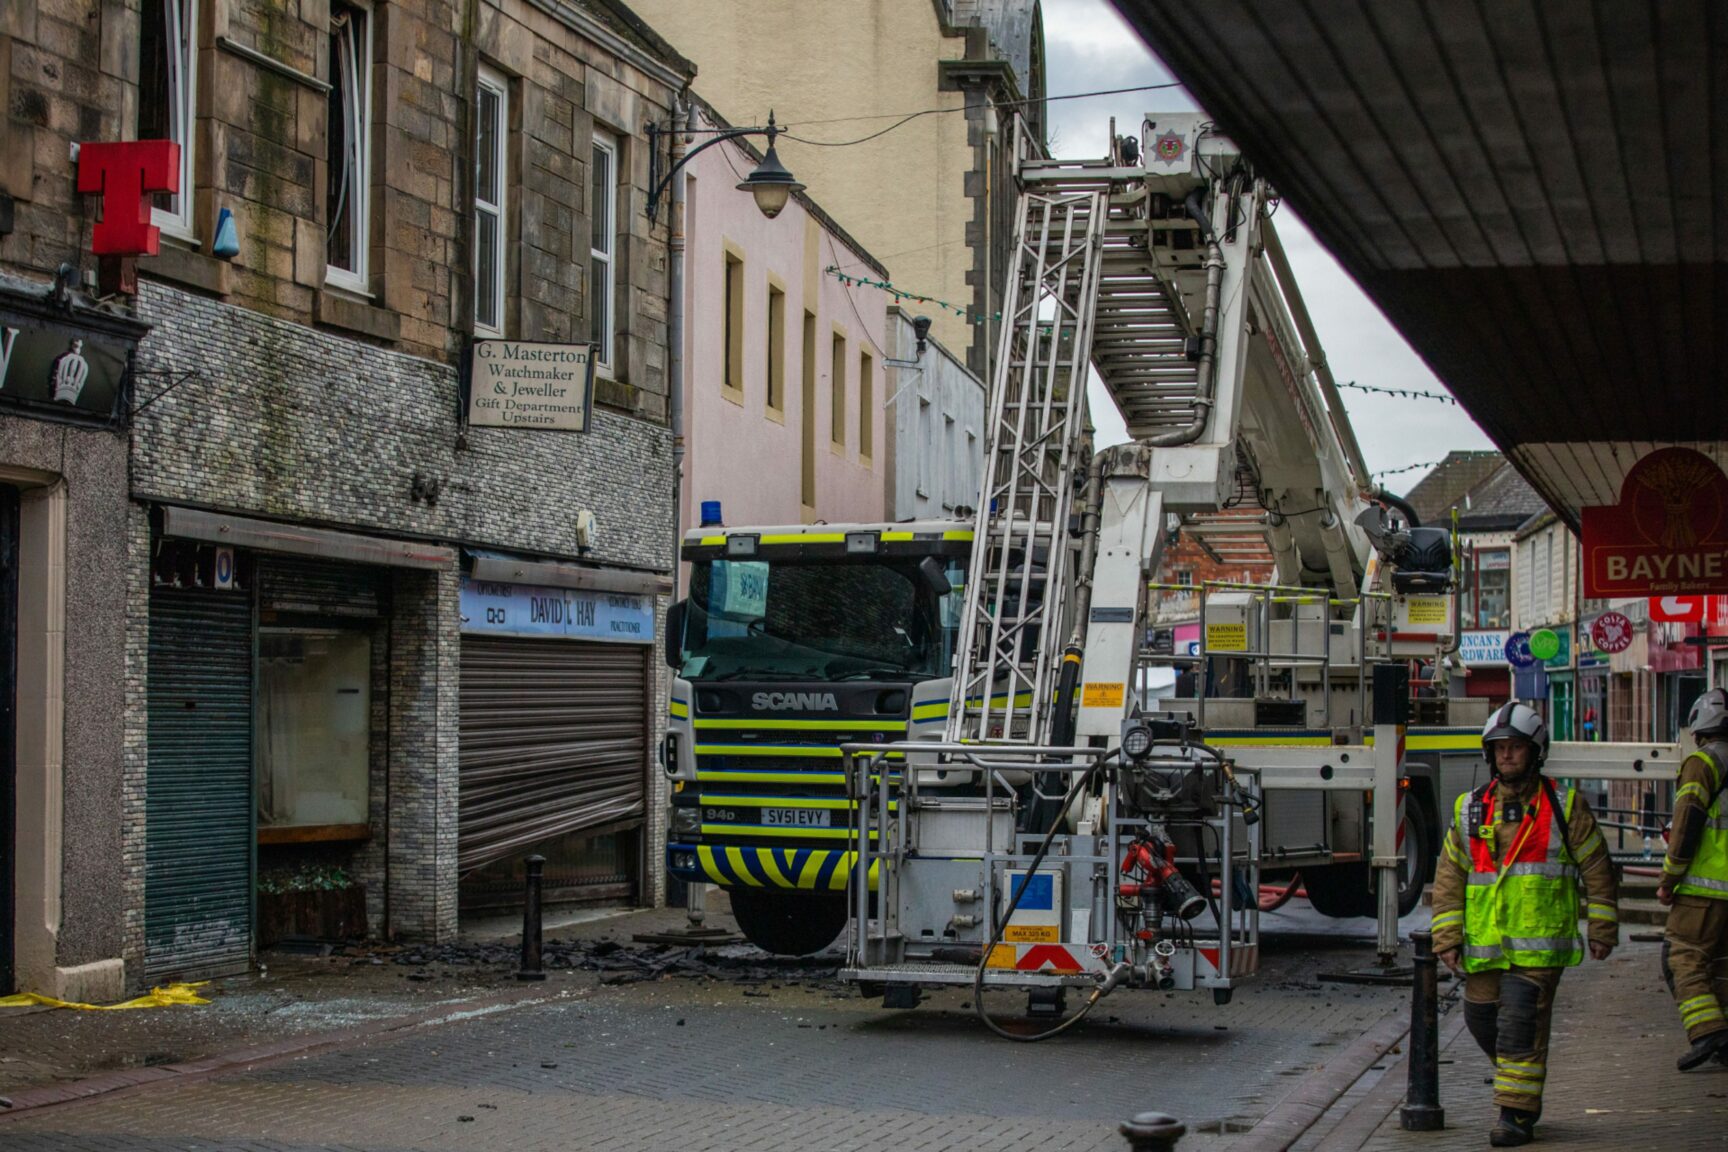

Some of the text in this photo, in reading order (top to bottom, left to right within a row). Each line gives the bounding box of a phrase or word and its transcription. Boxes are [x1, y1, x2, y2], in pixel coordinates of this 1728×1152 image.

[477, 342, 587, 364] G. Masterton
[488, 363, 575, 381] Watchmaker
[493, 380, 567, 398] & Jeweller
[475, 397, 581, 414] Gift Department
[501, 411, 556, 424] Upstairs
[1649, 582, 1679, 592] Family
[530, 596, 563, 624] DAVID
[576, 599, 596, 627] HAY
[1410, 600, 1445, 608] WARNING
[1209, 625, 1245, 633] WARNING
[1599, 615, 1626, 628] COSTA
[1598, 636, 1630, 651] COFFEE
[1086, 682, 1121, 690] WARNING
[751, 691, 839, 711] SCANIA
[706, 808, 823, 825] 94D SV51 EVY
